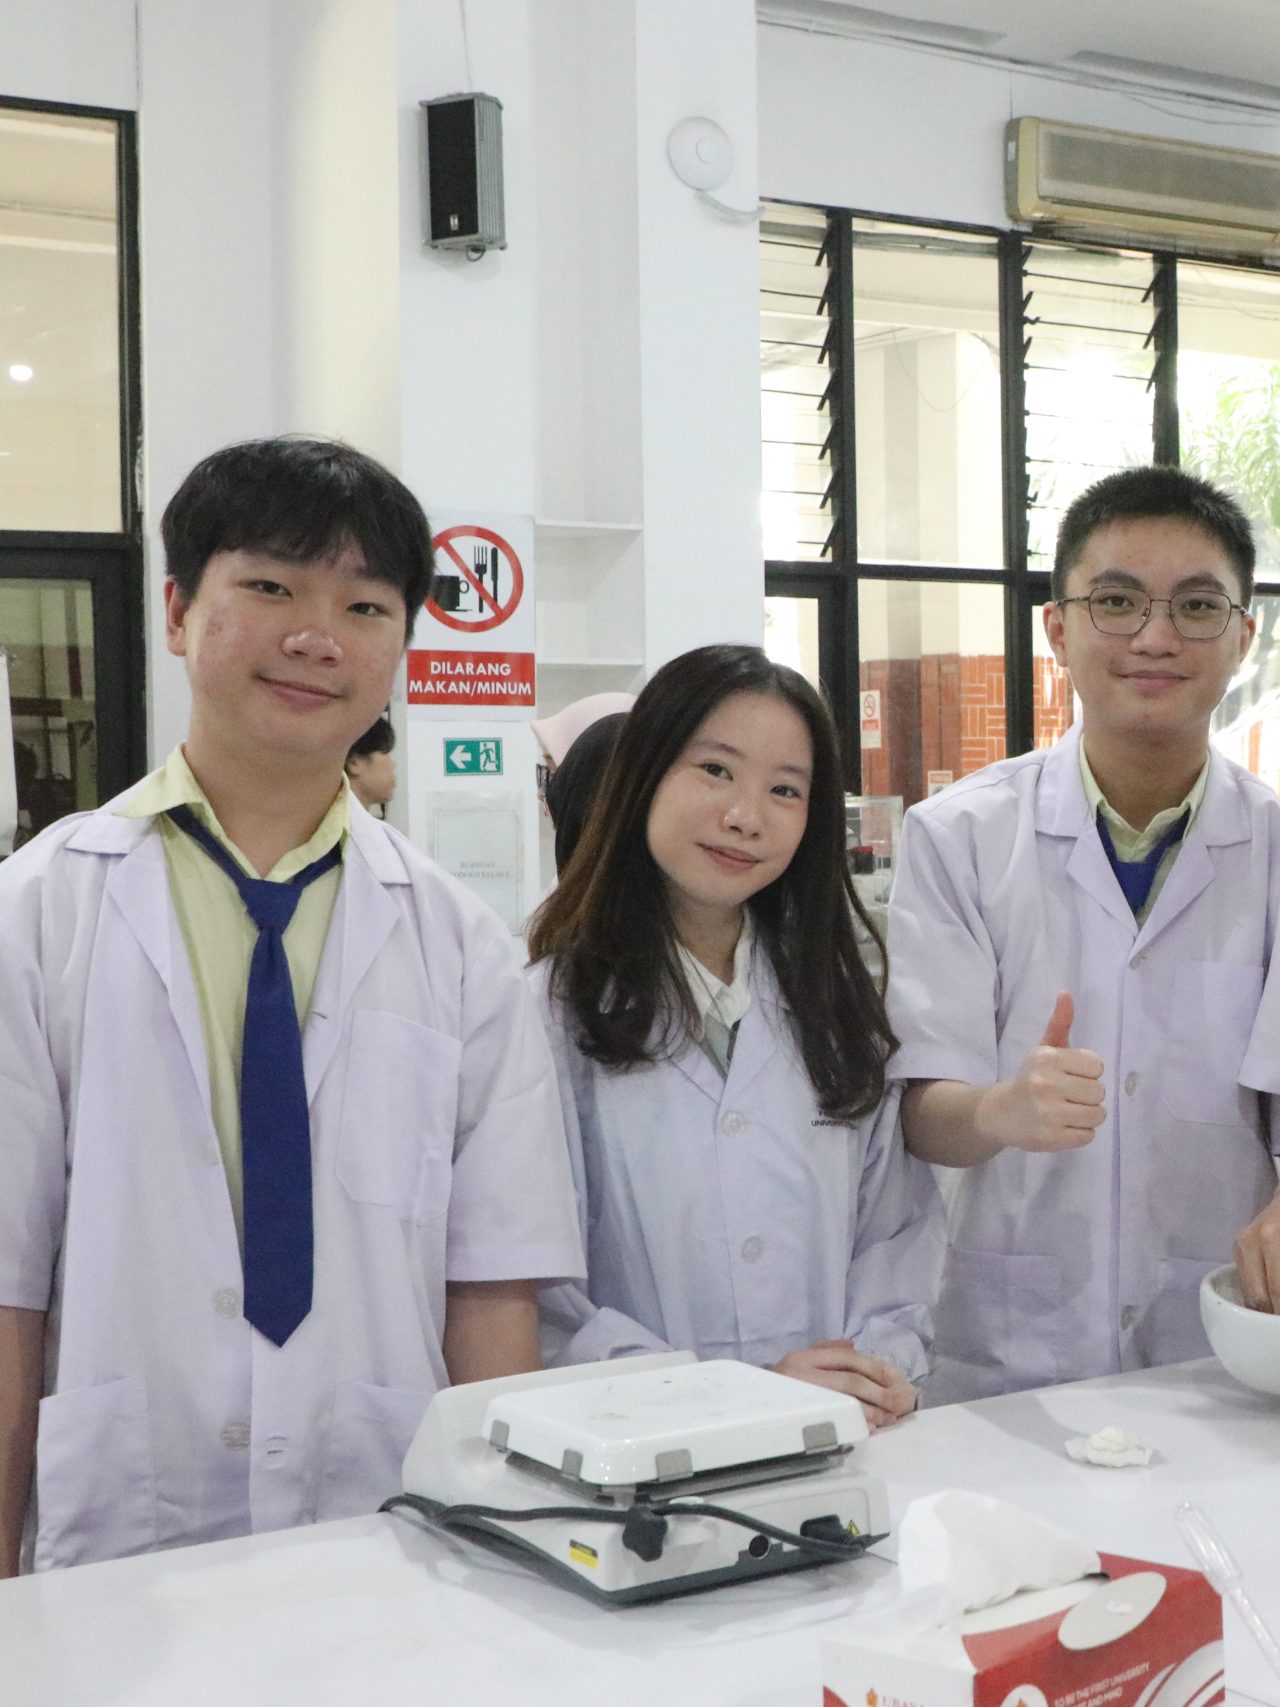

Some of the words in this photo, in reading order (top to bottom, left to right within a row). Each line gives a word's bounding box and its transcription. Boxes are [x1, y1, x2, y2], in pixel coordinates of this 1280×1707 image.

[430, 661, 512, 676] DILARANG
[409, 680, 532, 697] MAKAN/MINUM
[1075, 1687, 1090, 1701] THE
[1109, 1661, 1150, 1687] UNIVERSITY
[1103, 1685, 1123, 1702] MIND
